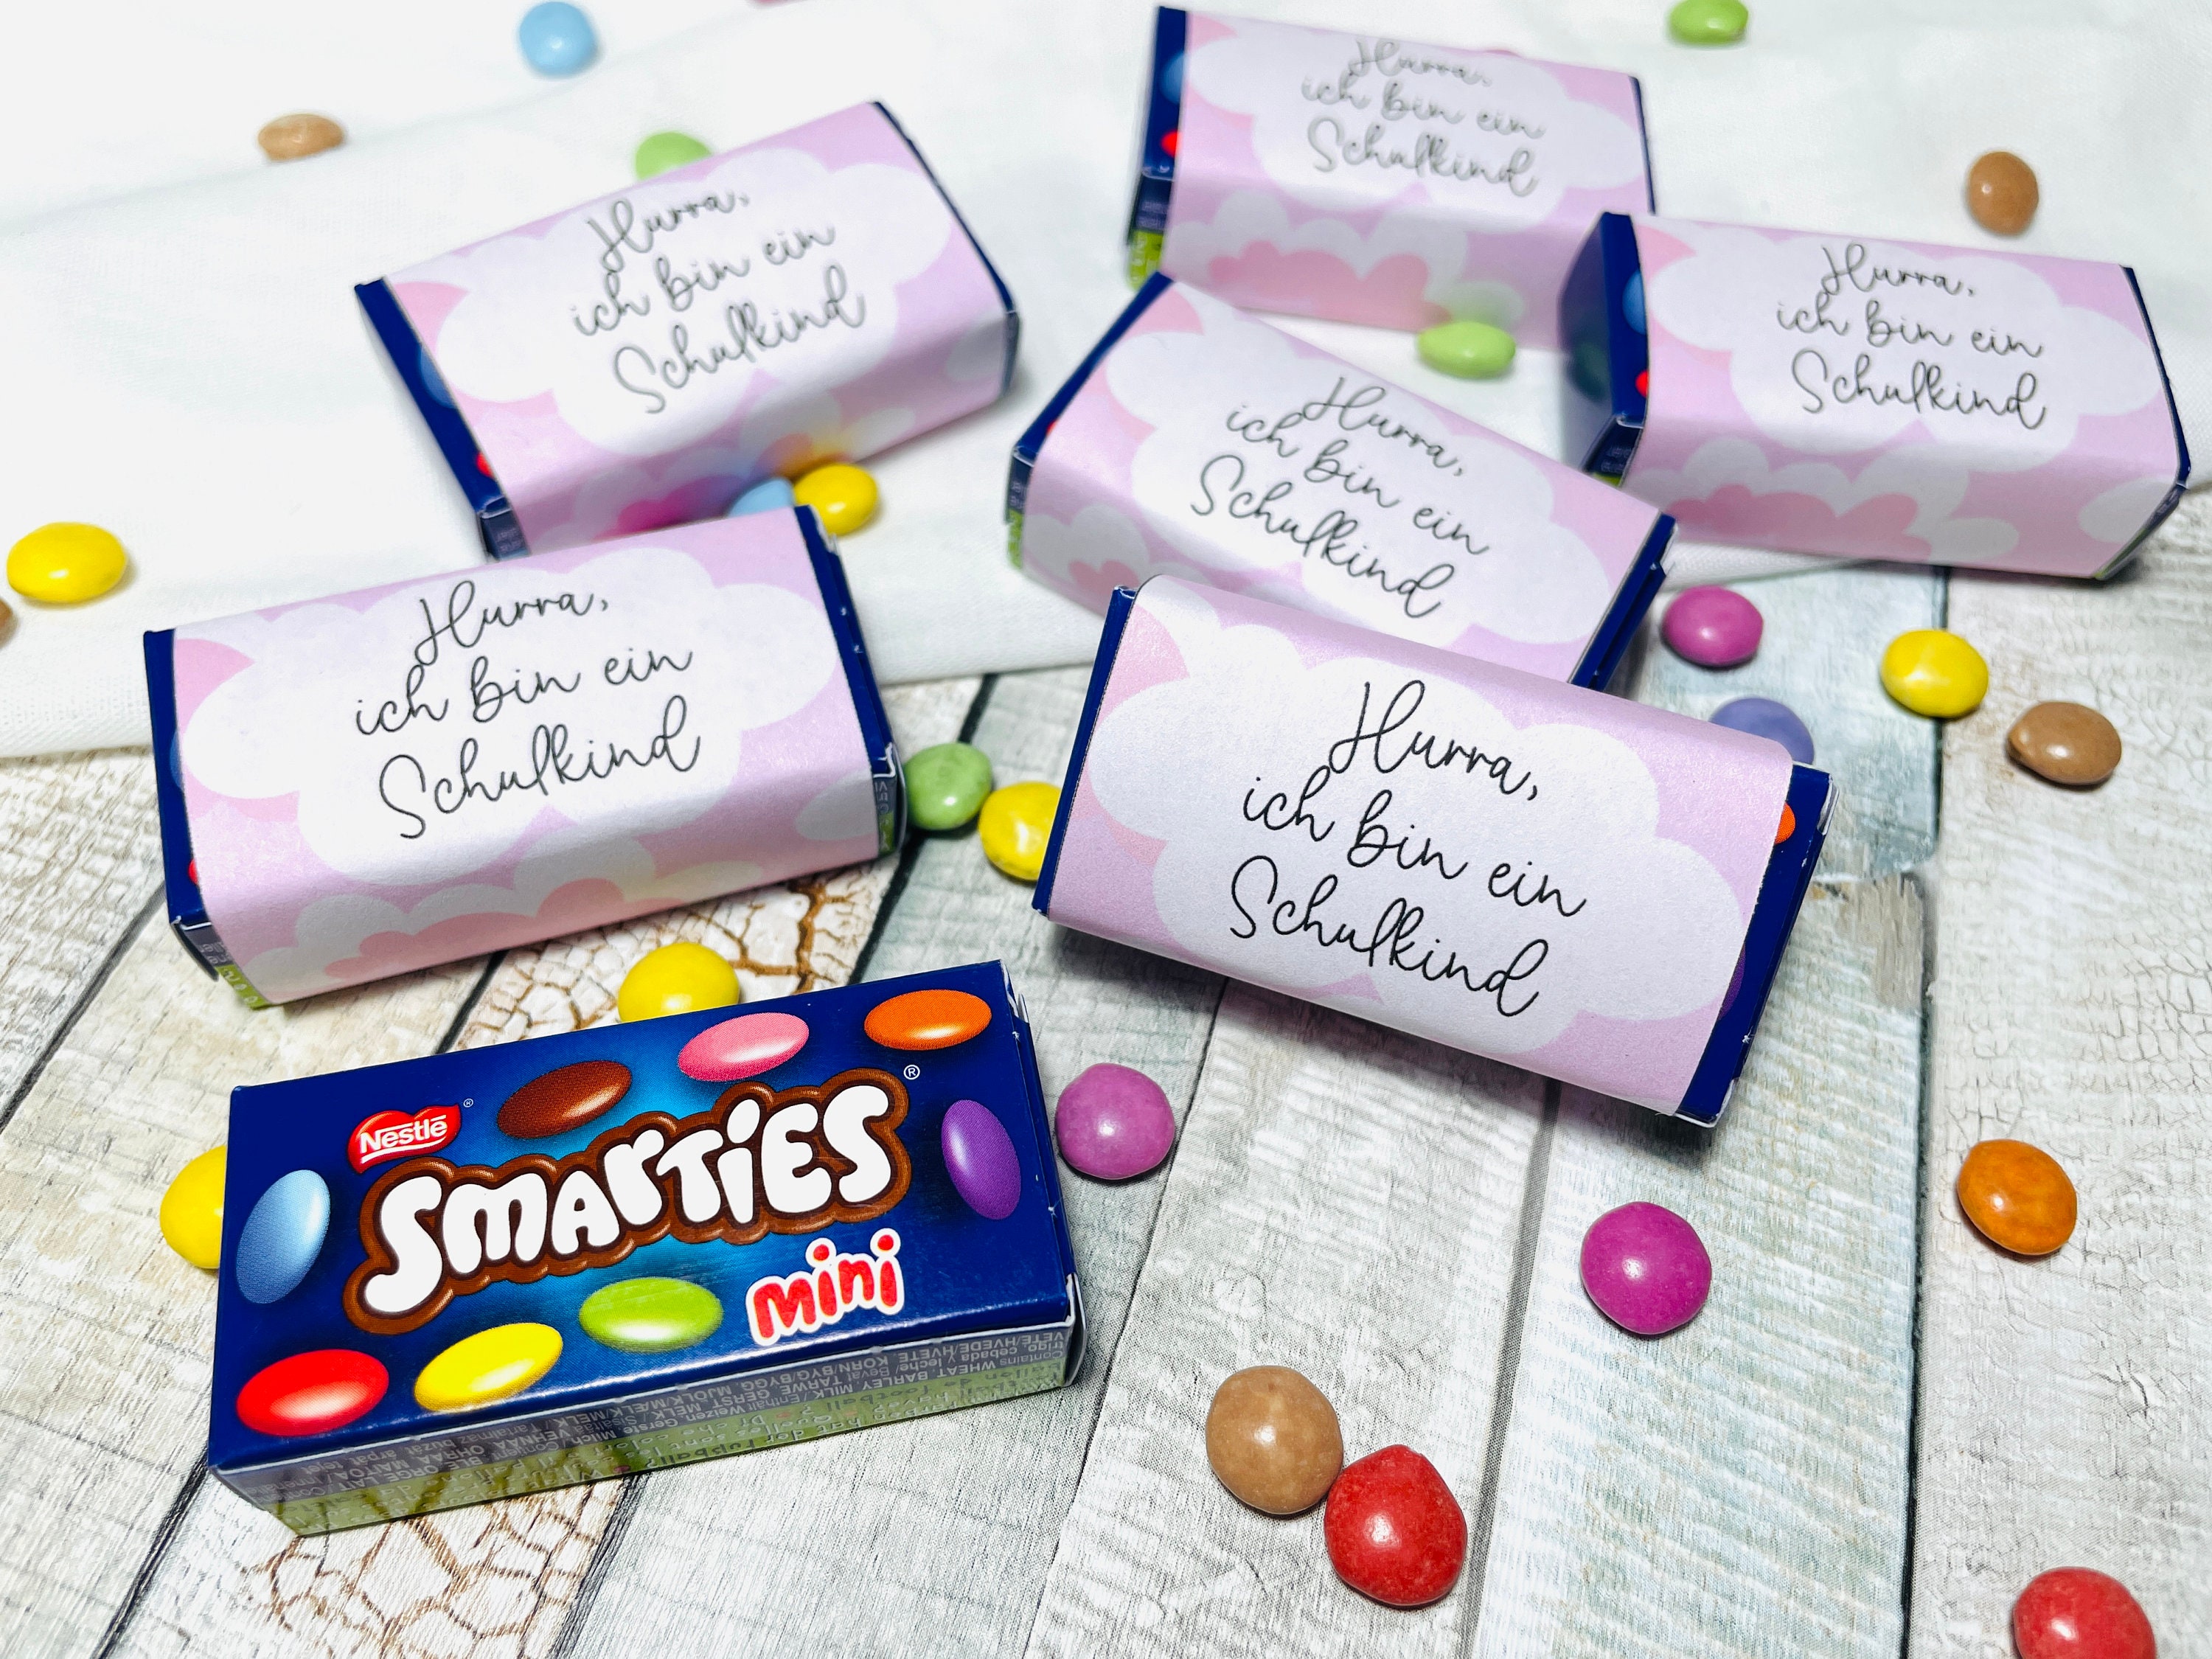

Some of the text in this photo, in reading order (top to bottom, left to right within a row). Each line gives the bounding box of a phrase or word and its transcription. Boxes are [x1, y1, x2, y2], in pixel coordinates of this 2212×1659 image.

[1301, 72, 1547, 139] ich bin ein
[1307, 116, 1540, 197] Schulkind
[570, 225, 835, 336] ich bin ein
[1820, 243, 1975, 296] Hurra,
[613, 264, 866, 414] Schulkind
[1775, 291, 2044, 358] ich bin ein
[1301, 377, 1463, 477] Hurra,
[1791, 348, 2047, 430] Schulkind
[1227, 404, 1489, 555] ich bin ein
[1191, 454, 1454, 619] Schulkind
[414, 580, 609, 666] Hurra,
[355, 647, 693, 735] ich bin ein
[1329, 679, 1538, 801] Hurra,
[380, 695, 701, 839] Schulkind
[1244, 765, 1587, 917] ich bin ein
[1230, 855, 1549, 1017] Schulkind
[748, 1231, 902, 1343] mini
[961, 1344, 1017, 1364] cebada
[999, 1349, 1062, 1368] Contains
